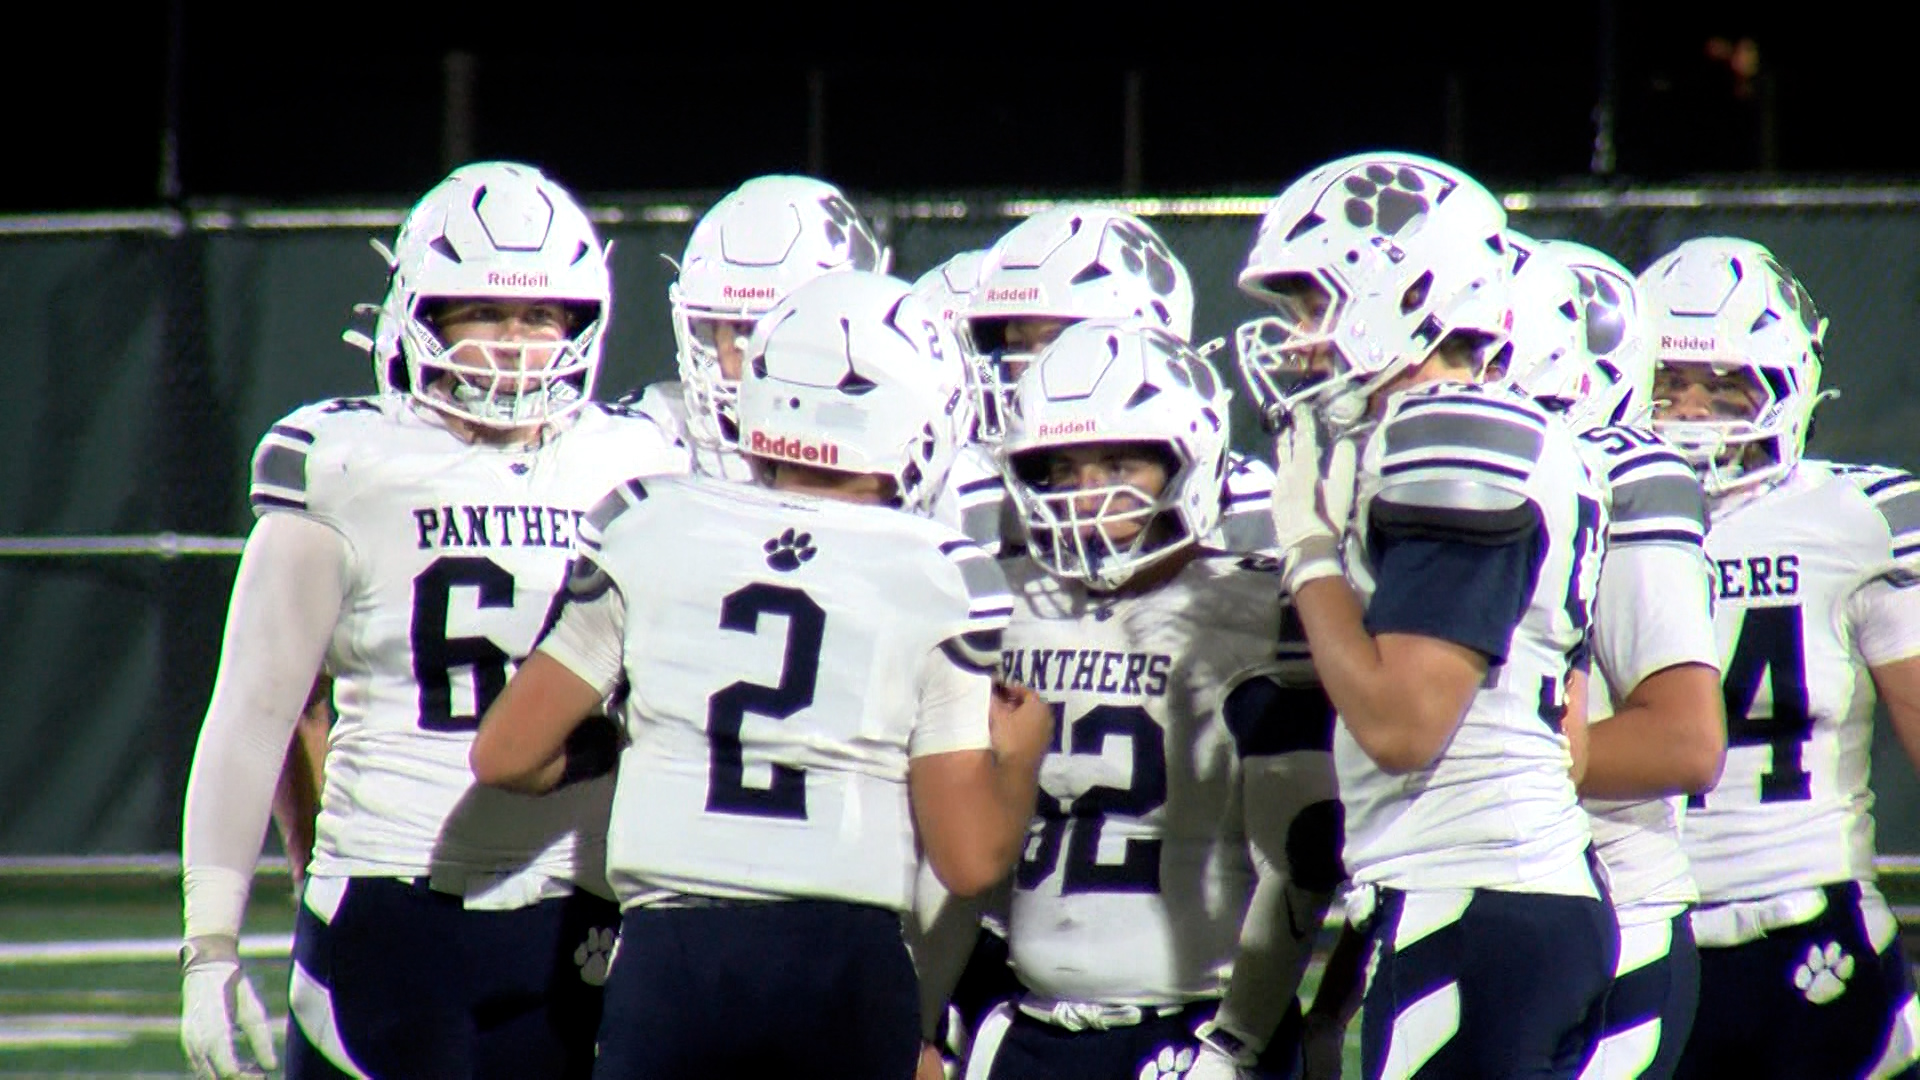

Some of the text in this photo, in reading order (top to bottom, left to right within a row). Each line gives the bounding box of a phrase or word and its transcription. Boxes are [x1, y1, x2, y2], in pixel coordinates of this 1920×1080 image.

[487, 272, 549, 287] Riddell
[723, 286, 775, 299] Riddell
[986, 287, 1039, 302] Riddell
[1661, 335, 1716, 350] Riddel
[1039, 420, 1096, 436] Riddell
[751, 430, 838, 465] Riddell
[1717, 555, 1799, 599] ERS
[410, 555, 573, 732] 6
[704, 582, 826, 821] 2
[1687, 603, 1816, 808] 4
